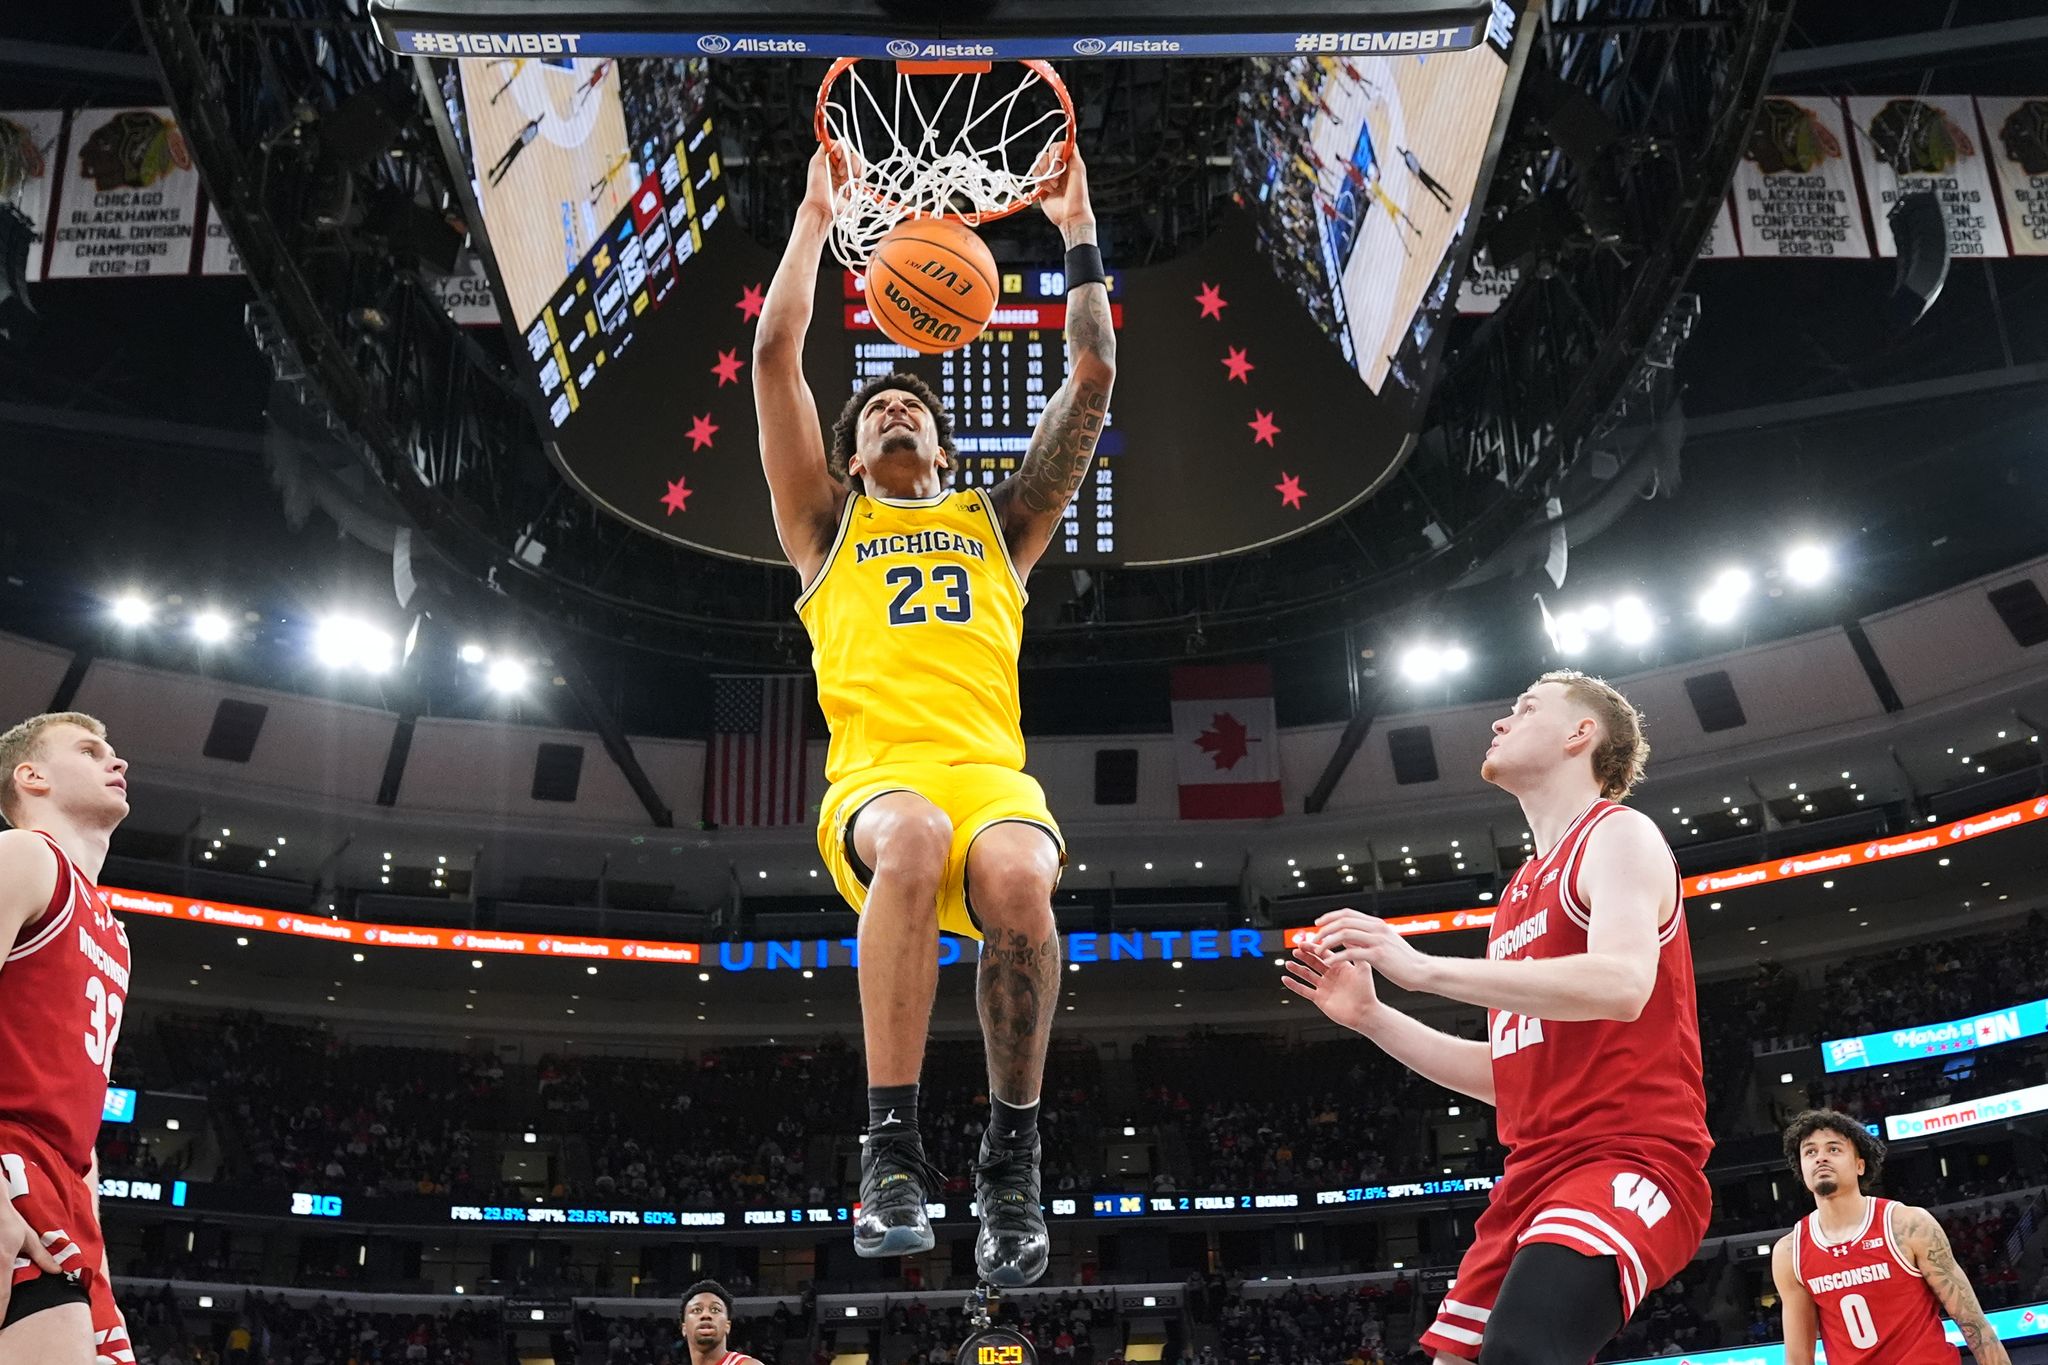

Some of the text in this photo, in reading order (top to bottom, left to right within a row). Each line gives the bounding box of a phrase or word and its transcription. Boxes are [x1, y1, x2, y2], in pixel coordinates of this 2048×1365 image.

[412, 32, 580, 54] #B1GMBBT
[732, 38, 808, 52] Allstate
[1107, 39, 1181, 53] Allstate
[1295, 27, 1459, 53] #B1GMBBT
[920, 42, 994, 57] Allstate
[1763, 176, 1826, 189] CHICAGO
[94, 192, 163, 208] CHICAGO
[1747, 188, 1846, 203] BLACKHAWKS
[72, 208, 181, 225] BLACKHAWKS
[1761, 202, 1836, 215] WESTERN
[1751, 214, 1851, 229] CONFERENCE
[57, 226, 125, 243] CENTRAL
[130, 225, 192, 241] DIVISION
[1761, 228, 1846, 242] CHAMPIONS
[75, 242, 168, 259] CHAMPIONS
[1040, 272, 1064, 296] 50
[884, 280, 962, 342] Wilson
[855, 530, 985, 564] MICHIGAN
[885, 564, 972, 626] 23
[1489, 907, 1548, 960] WISCONSIN
[719, 936, 961, 971] UNITD
[1069, 929, 1264, 964] ENTER
[84, 975, 124, 1084] 32
[98, 1179, 162, 1200] :33 PM
[1052, 1199, 1076, 1215] 50
[1179, 1198, 1190, 1210] 2
[1195, 1197, 1235, 1210] FOULS
[1241, 1195, 1251, 1208] 2
[1255, 1194, 1298, 1209] BONUS
[609, 1210, 640, 1224] FT%
[643, 1211, 676, 1225] 60%
[681, 1212, 725, 1226] BONUS
[744, 1210, 785, 1225] FOULS
[791, 1209, 802, 1222] 5
[837, 1208, 848, 1221] 3
[1807, 1262, 1891, 1295] WISCONSIN
[1839, 1293, 1879, 1350] 0
[978, 1345, 1023, 1365] 10:29
